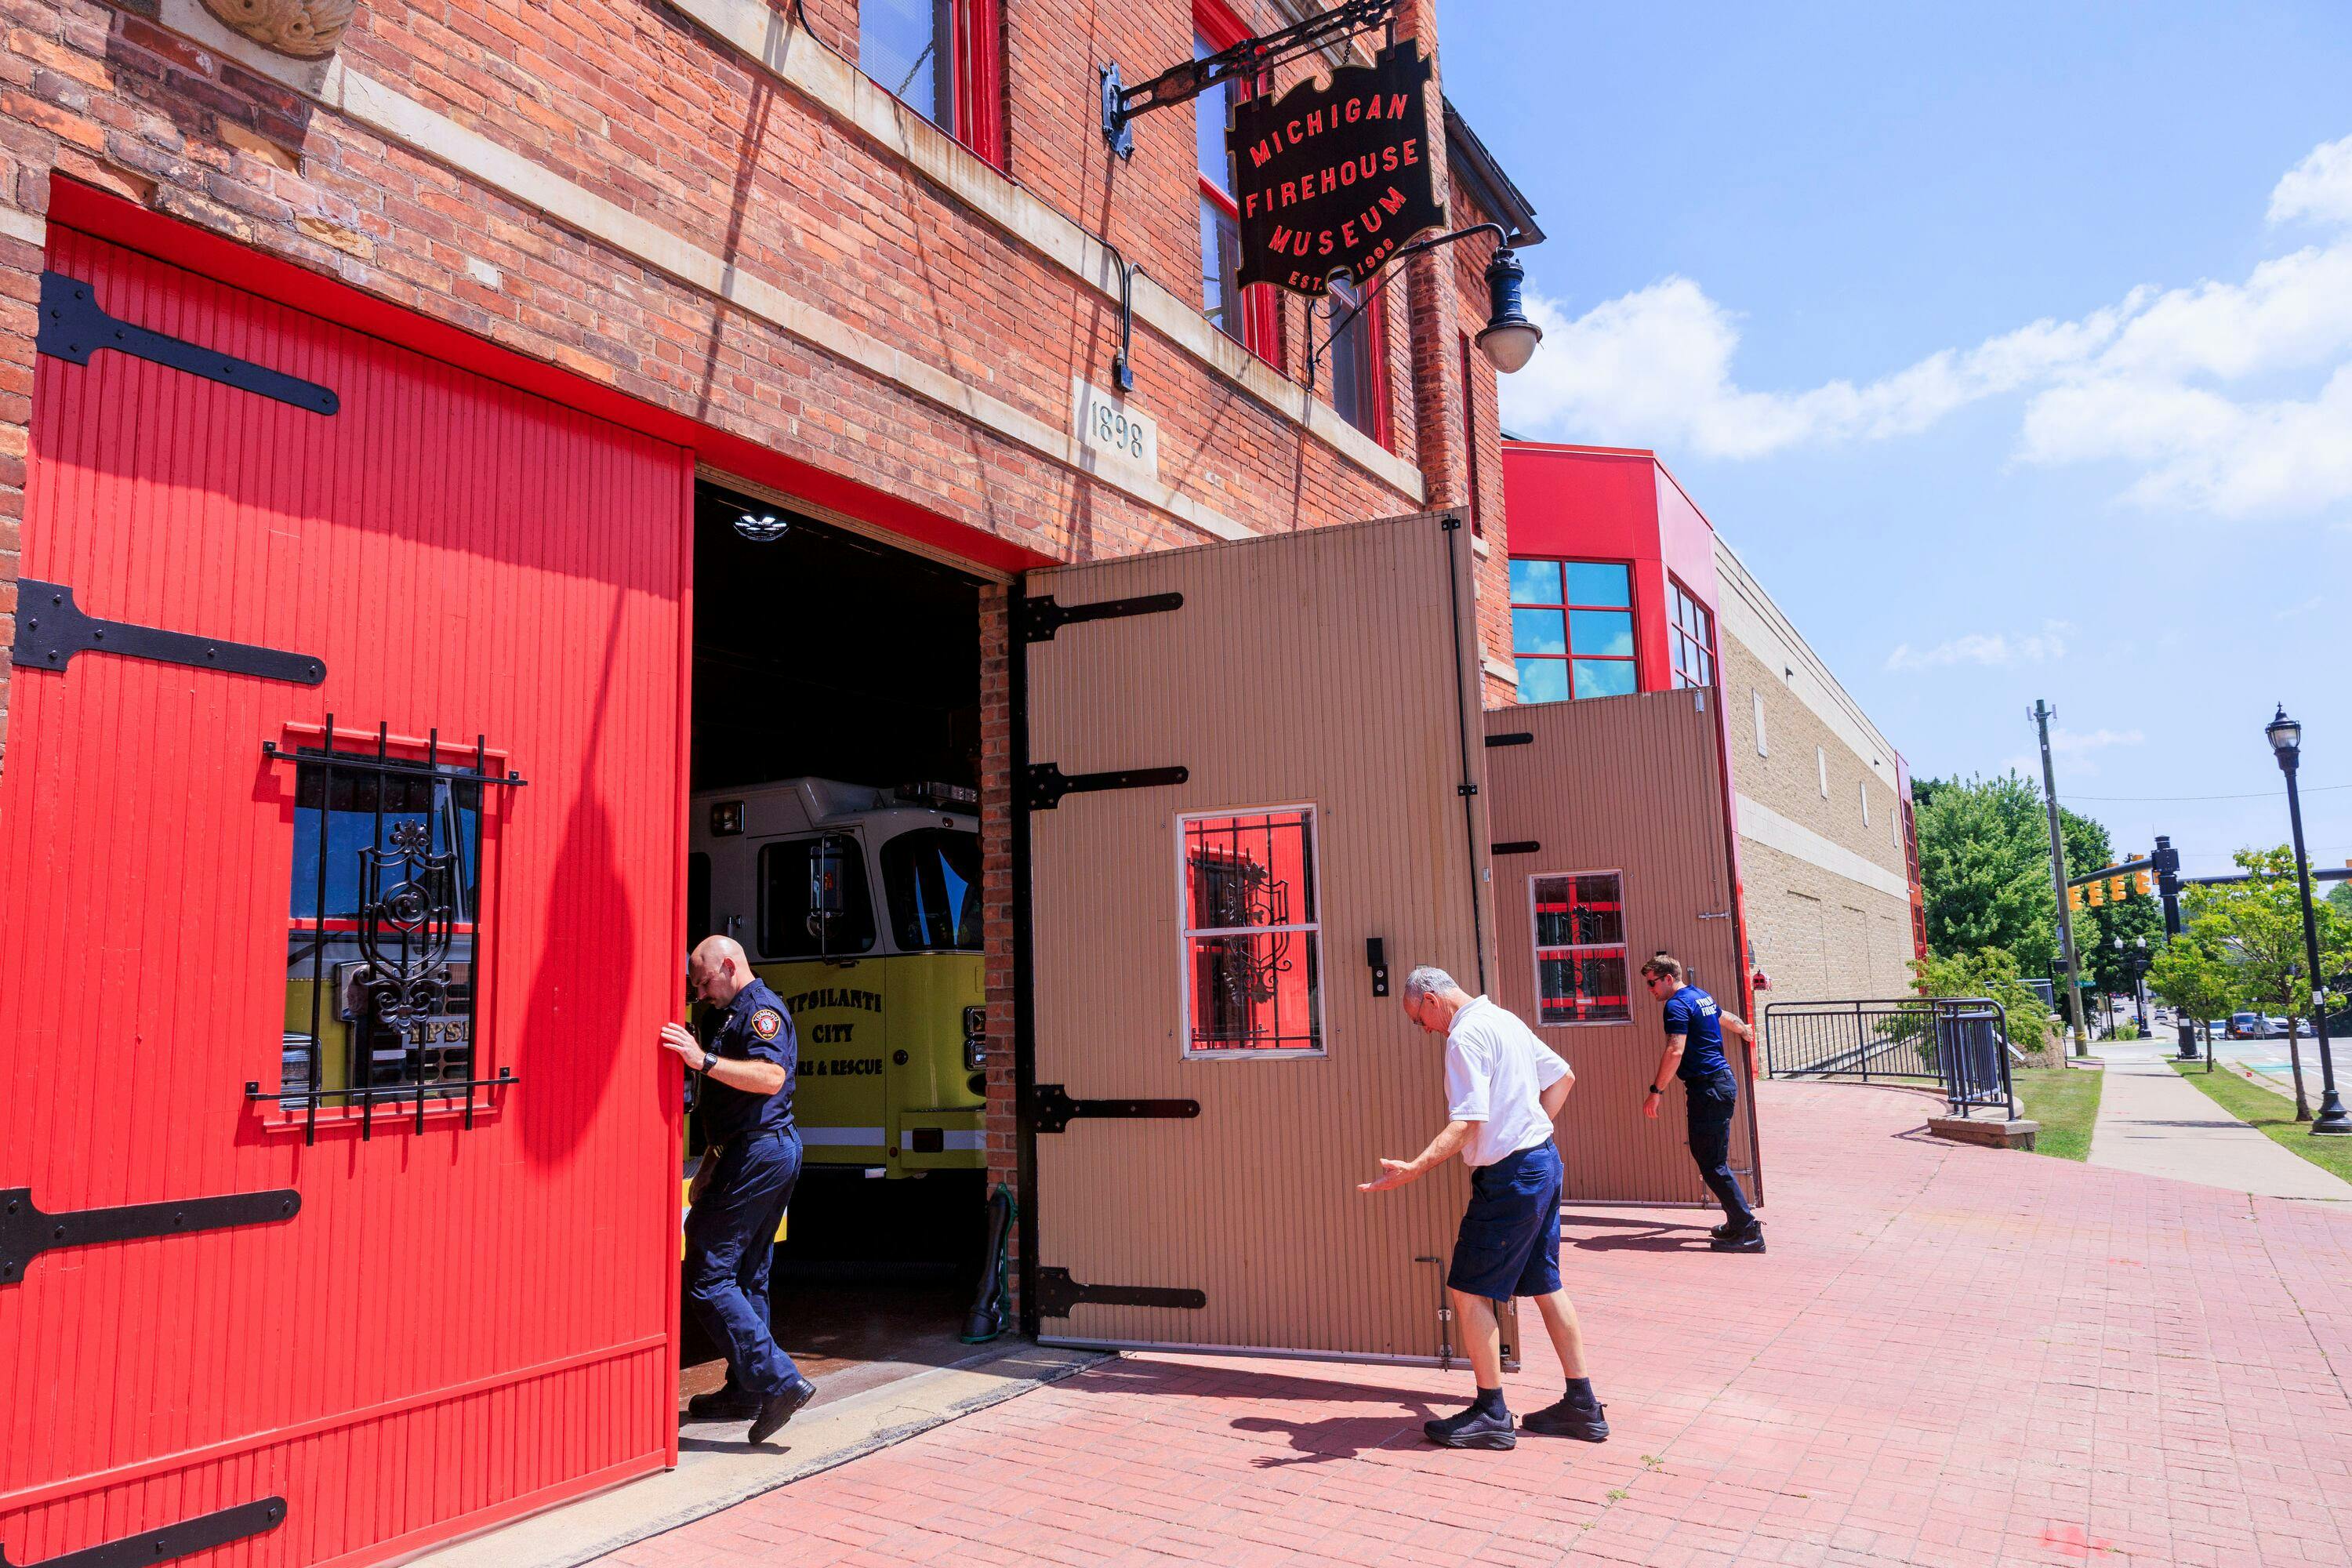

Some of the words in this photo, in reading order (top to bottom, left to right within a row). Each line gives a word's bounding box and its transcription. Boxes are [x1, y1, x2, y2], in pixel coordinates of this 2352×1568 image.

[1250, 94, 1409, 168] MICHIGAN
[1246, 138, 1419, 219] FIREHOUSE
[1269, 187, 1406, 256] MUSEUM
[1288, 271, 1323, 292] EST.
[1356, 238, 1394, 275] 1998
[1092, 401, 1143, 459] 1898
[786, 988, 882, 1015] YPSILANTI
[812, 1023, 855, 1044] CITY
[796, 1060, 815, 1076] RE
[816, 1060, 827, 1076] &
[830, 1058, 883, 1076] RESCUE
